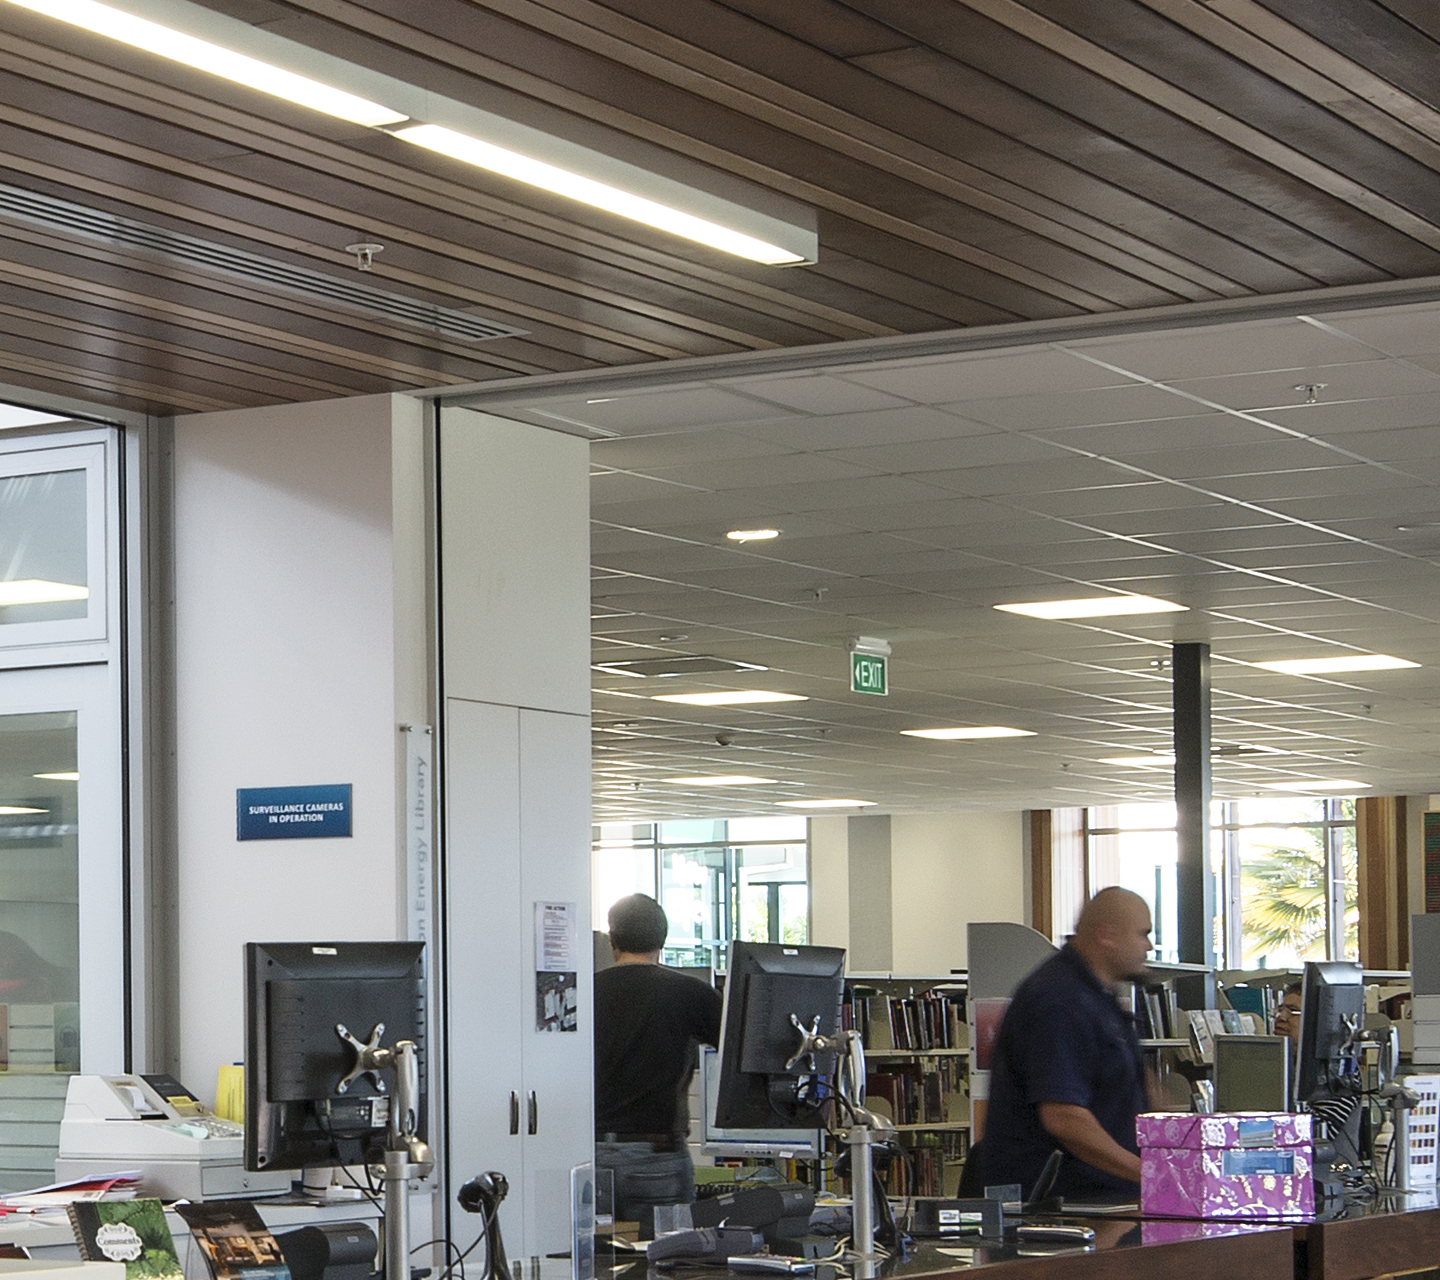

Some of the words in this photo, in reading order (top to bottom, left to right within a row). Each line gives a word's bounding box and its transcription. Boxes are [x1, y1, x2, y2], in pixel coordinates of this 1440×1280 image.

[861, 661, 882, 688] EXIT
[415, 756, 428, 831] Library
[248, 803, 304, 814] SURVEILLANCE
[305, 802, 344, 812] CAMERAS
[268, 815, 278, 823] IN
[279, 813, 324, 823] OPERATION
[416, 838, 428, 911] Energy
[98, 1237, 140, 1245] Comments
